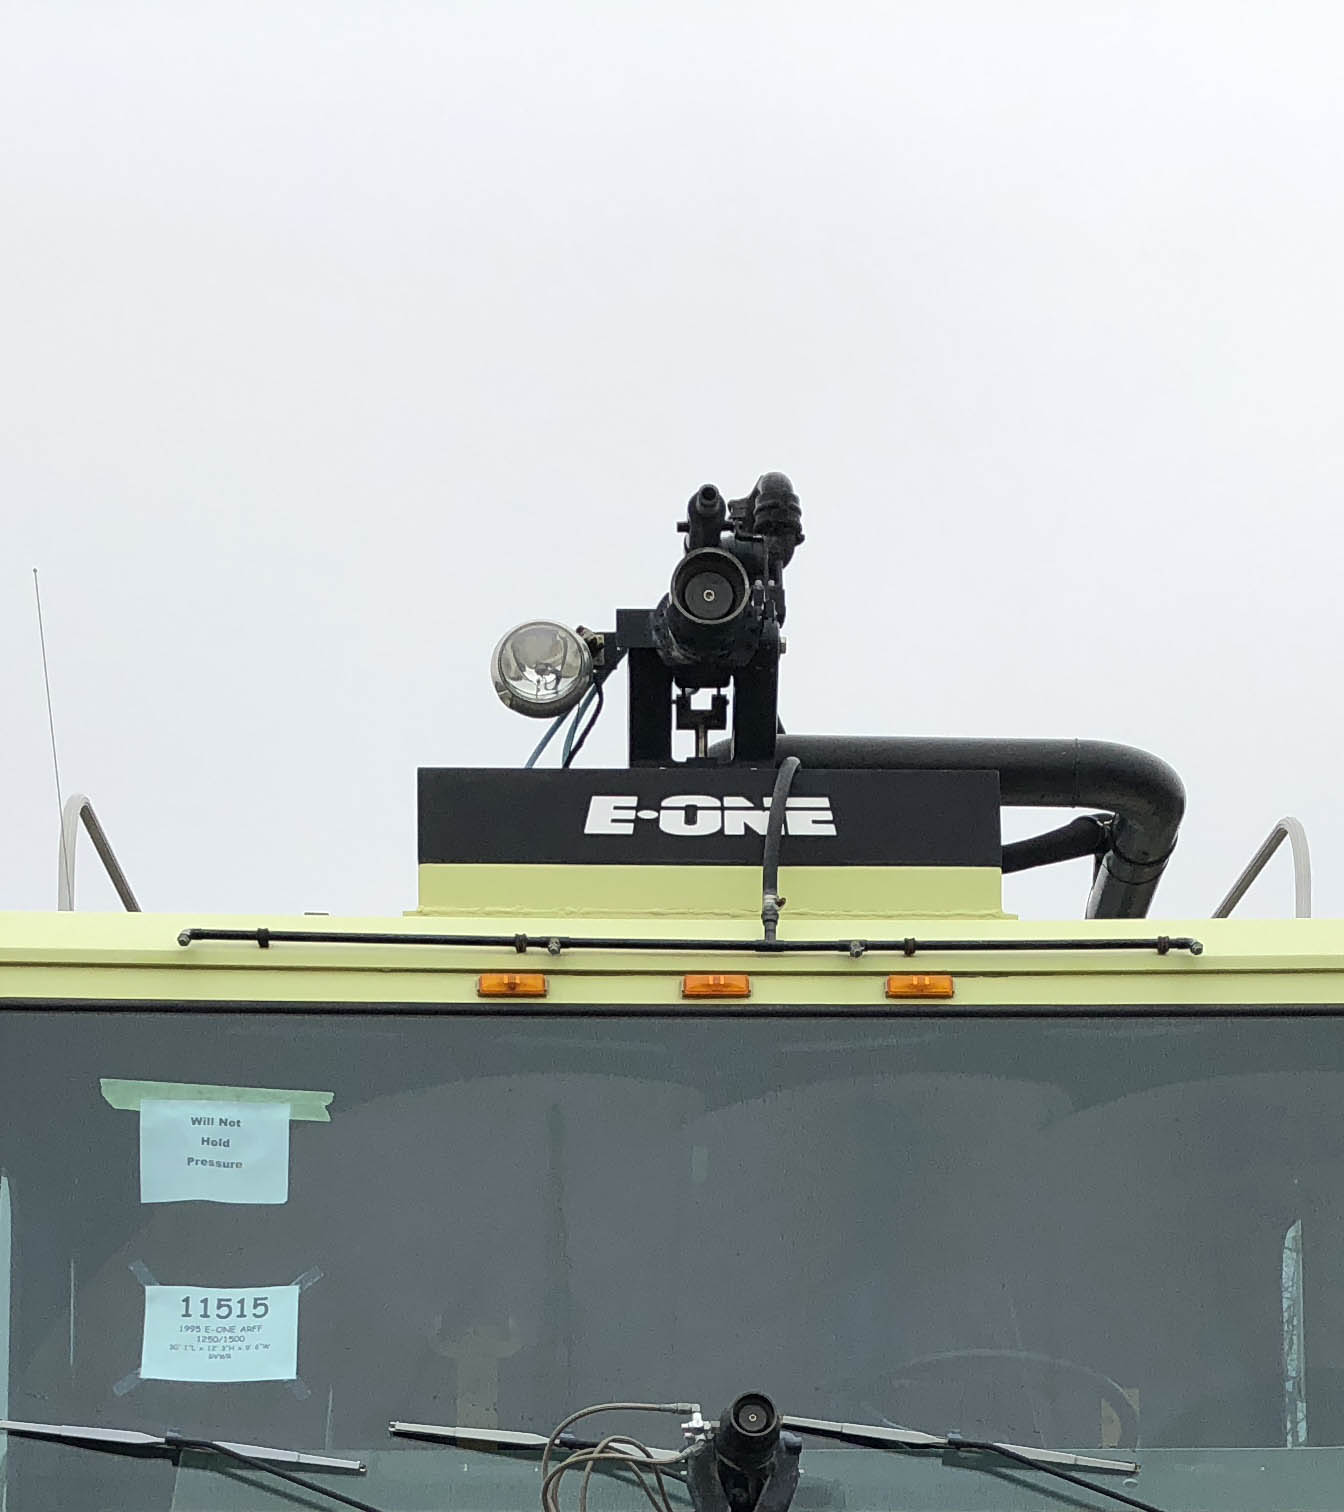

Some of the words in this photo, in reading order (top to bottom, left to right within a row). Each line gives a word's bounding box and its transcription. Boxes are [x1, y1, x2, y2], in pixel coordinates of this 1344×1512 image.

[190, 1116, 215, 1126] Will
[218, 1117, 241, 1128] Not
[200, 1136, 231, 1148] Hold
[186, 1157, 244, 1169] Pressure
[181, 1296, 269, 1319] 11515
